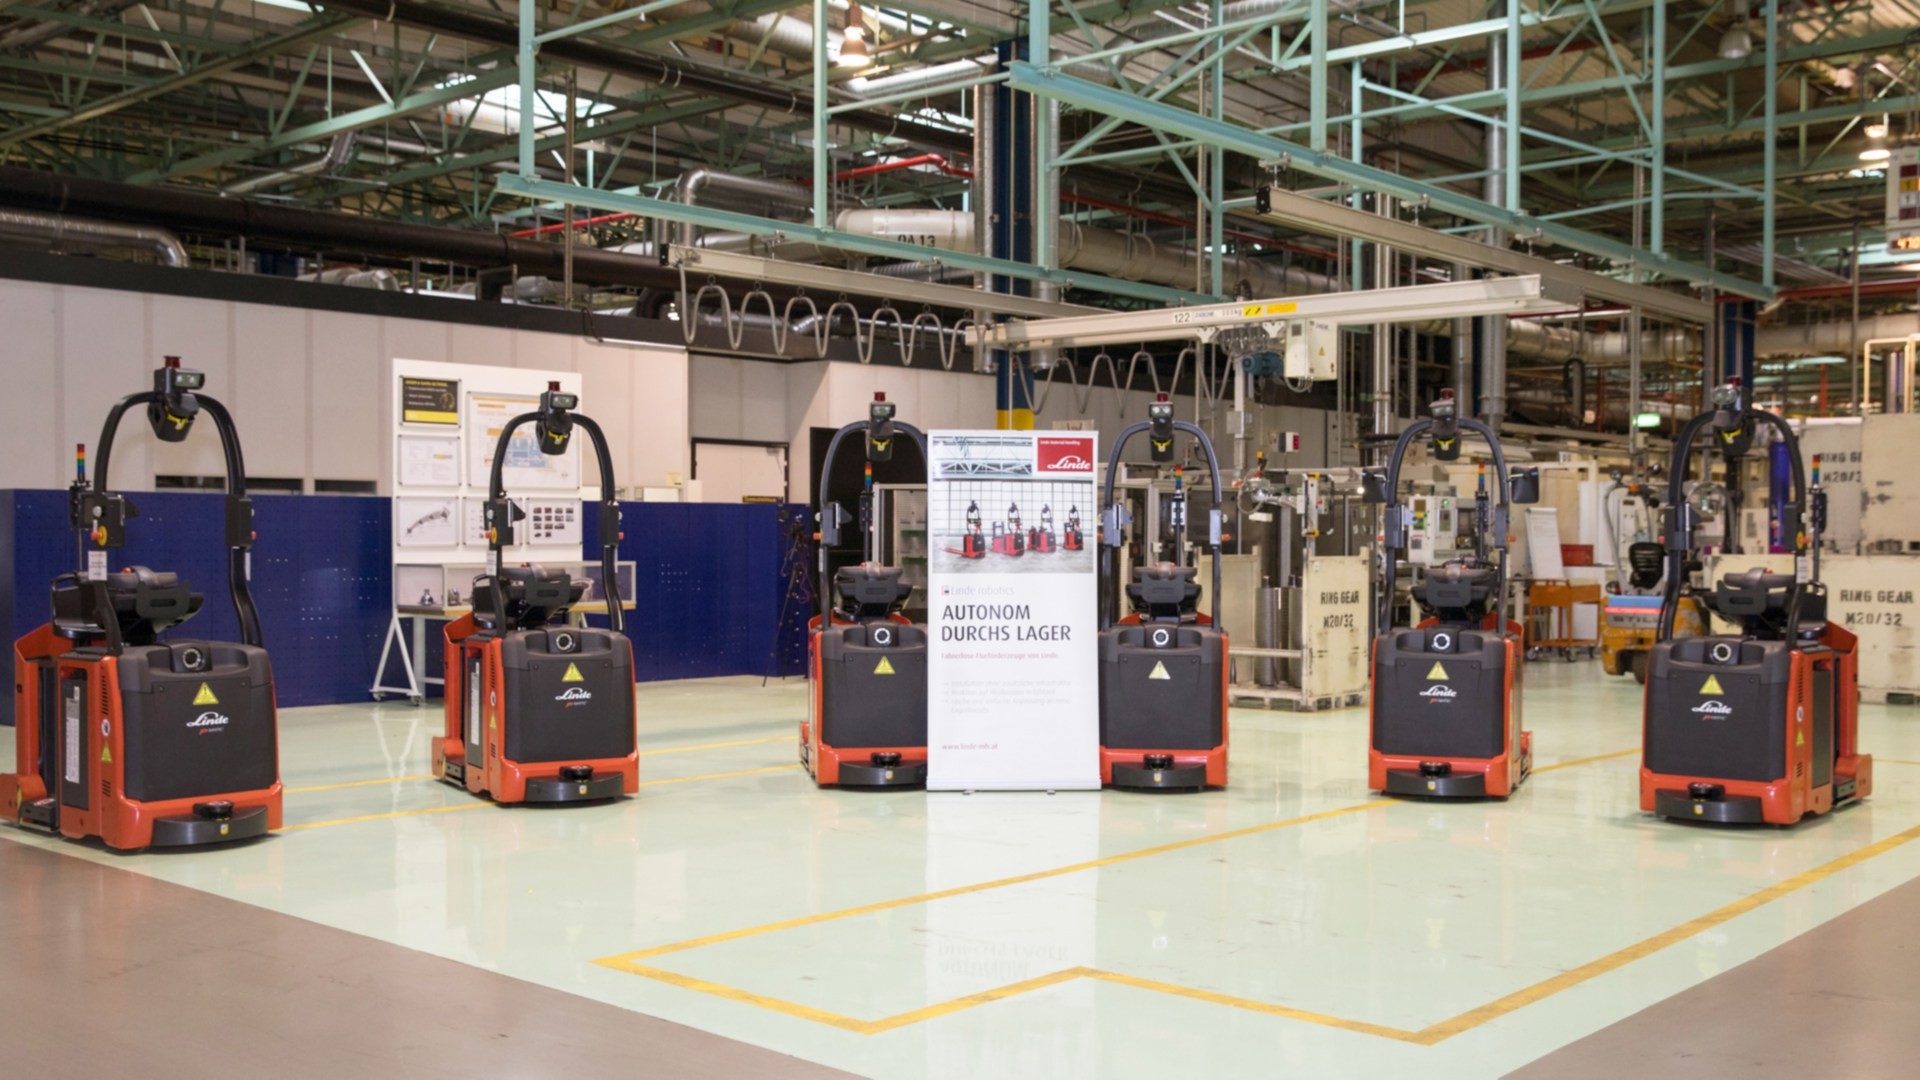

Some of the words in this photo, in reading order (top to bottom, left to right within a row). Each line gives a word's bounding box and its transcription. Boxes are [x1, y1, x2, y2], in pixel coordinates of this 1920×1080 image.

[1174, 313, 1191, 323] 122
[1047, 455, 1091, 470] Linde
[951, 585, 976, 595] Linde
[978, 585, 1015, 595] robotics
[1320, 591, 1338, 605] RING
[1340, 590, 1359, 604] GEAR
[1840, 589, 1872, 602] RING
[1877, 590, 1914, 604] GEAR
[942, 604, 1030, 620] AUTONOM
[1845, 612, 1902, 627] M20/32
[941, 625, 1010, 641] DURCHS
[1017, 625, 1071, 641] LAGER
[555, 687, 592, 701] Linde
[1419, 684, 1457, 697] Linde
[1691, 700, 1732, 714] Linde
[186, 711, 229, 727] Linde
